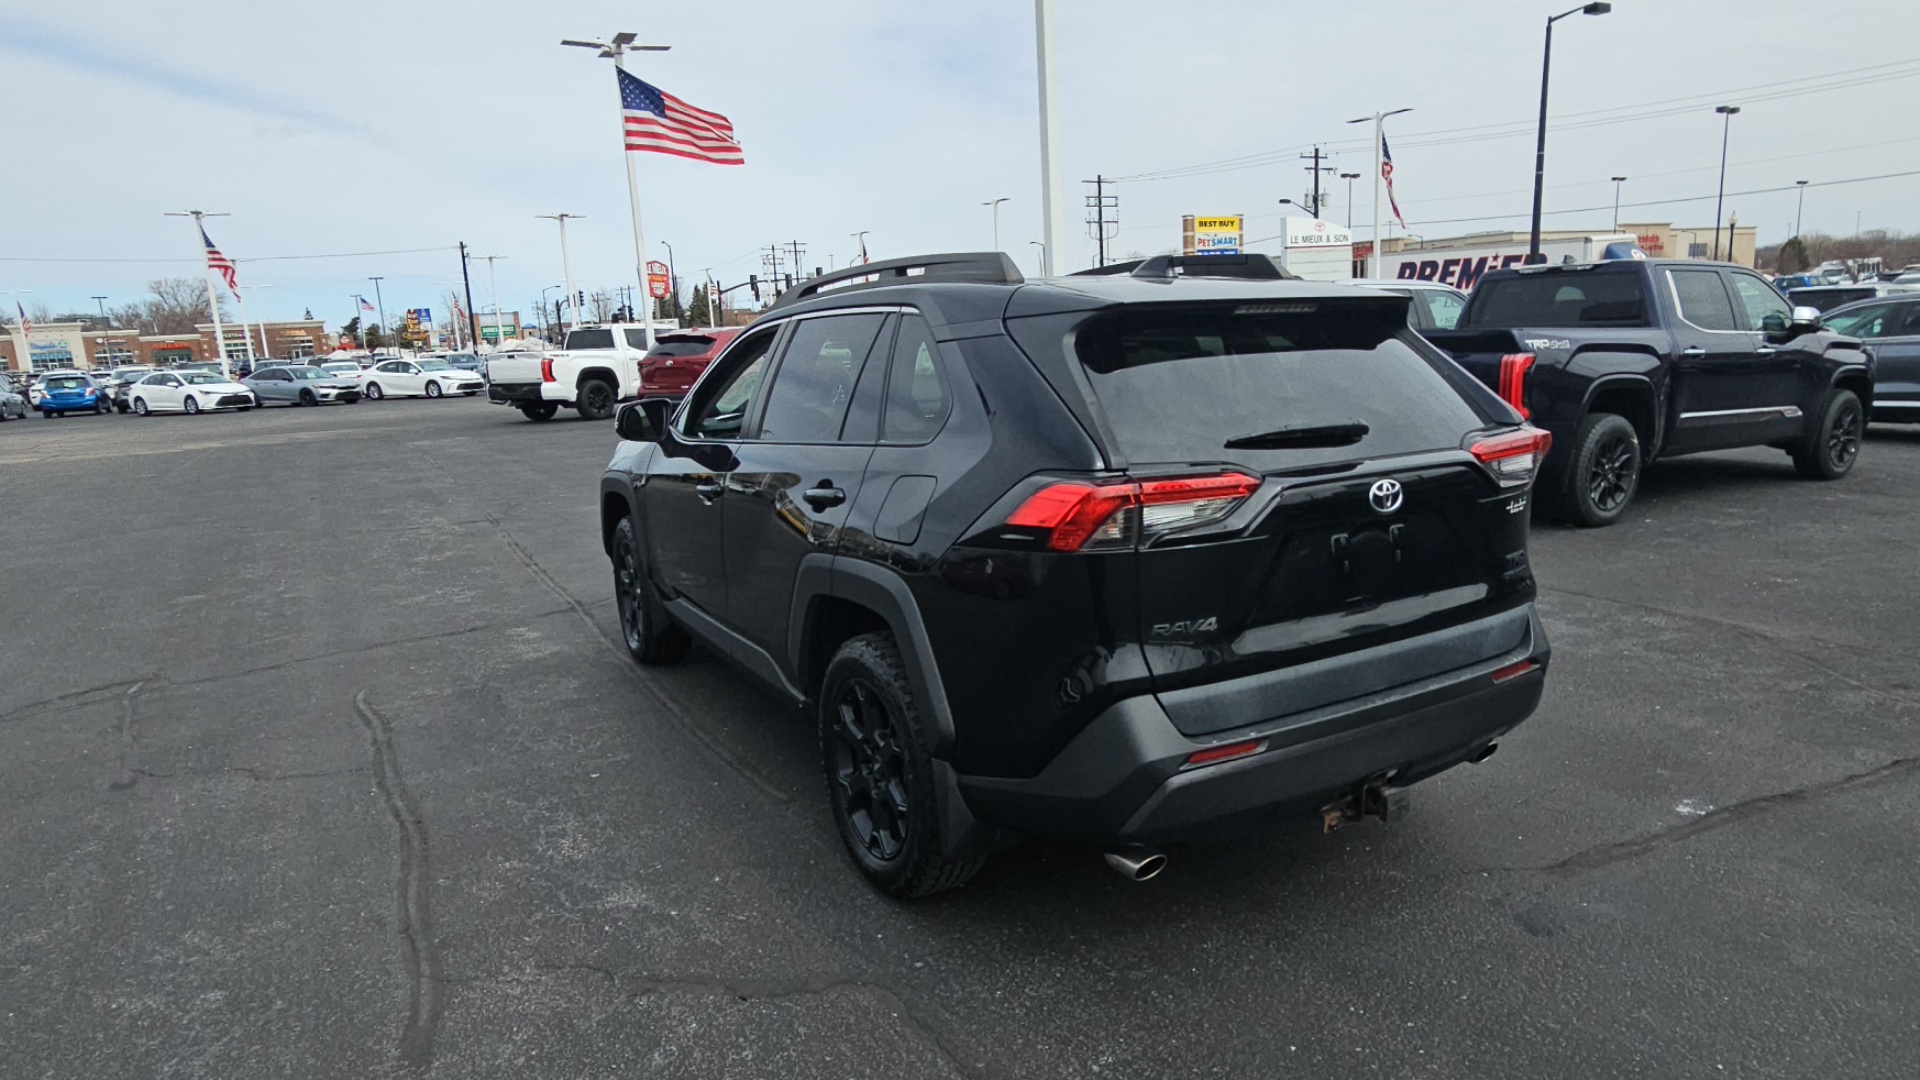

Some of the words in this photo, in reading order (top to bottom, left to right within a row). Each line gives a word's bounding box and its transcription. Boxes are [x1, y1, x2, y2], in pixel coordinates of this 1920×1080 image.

[1198, 220, 1218, 228] BEST
[1218, 220, 1236, 228] BUY
[1290, 235, 1300, 244] LE
[1301, 234, 1324, 243] MIEUX
[1333, 233, 1349, 243] SON
[1151, 616, 1218, 636] RAV4
